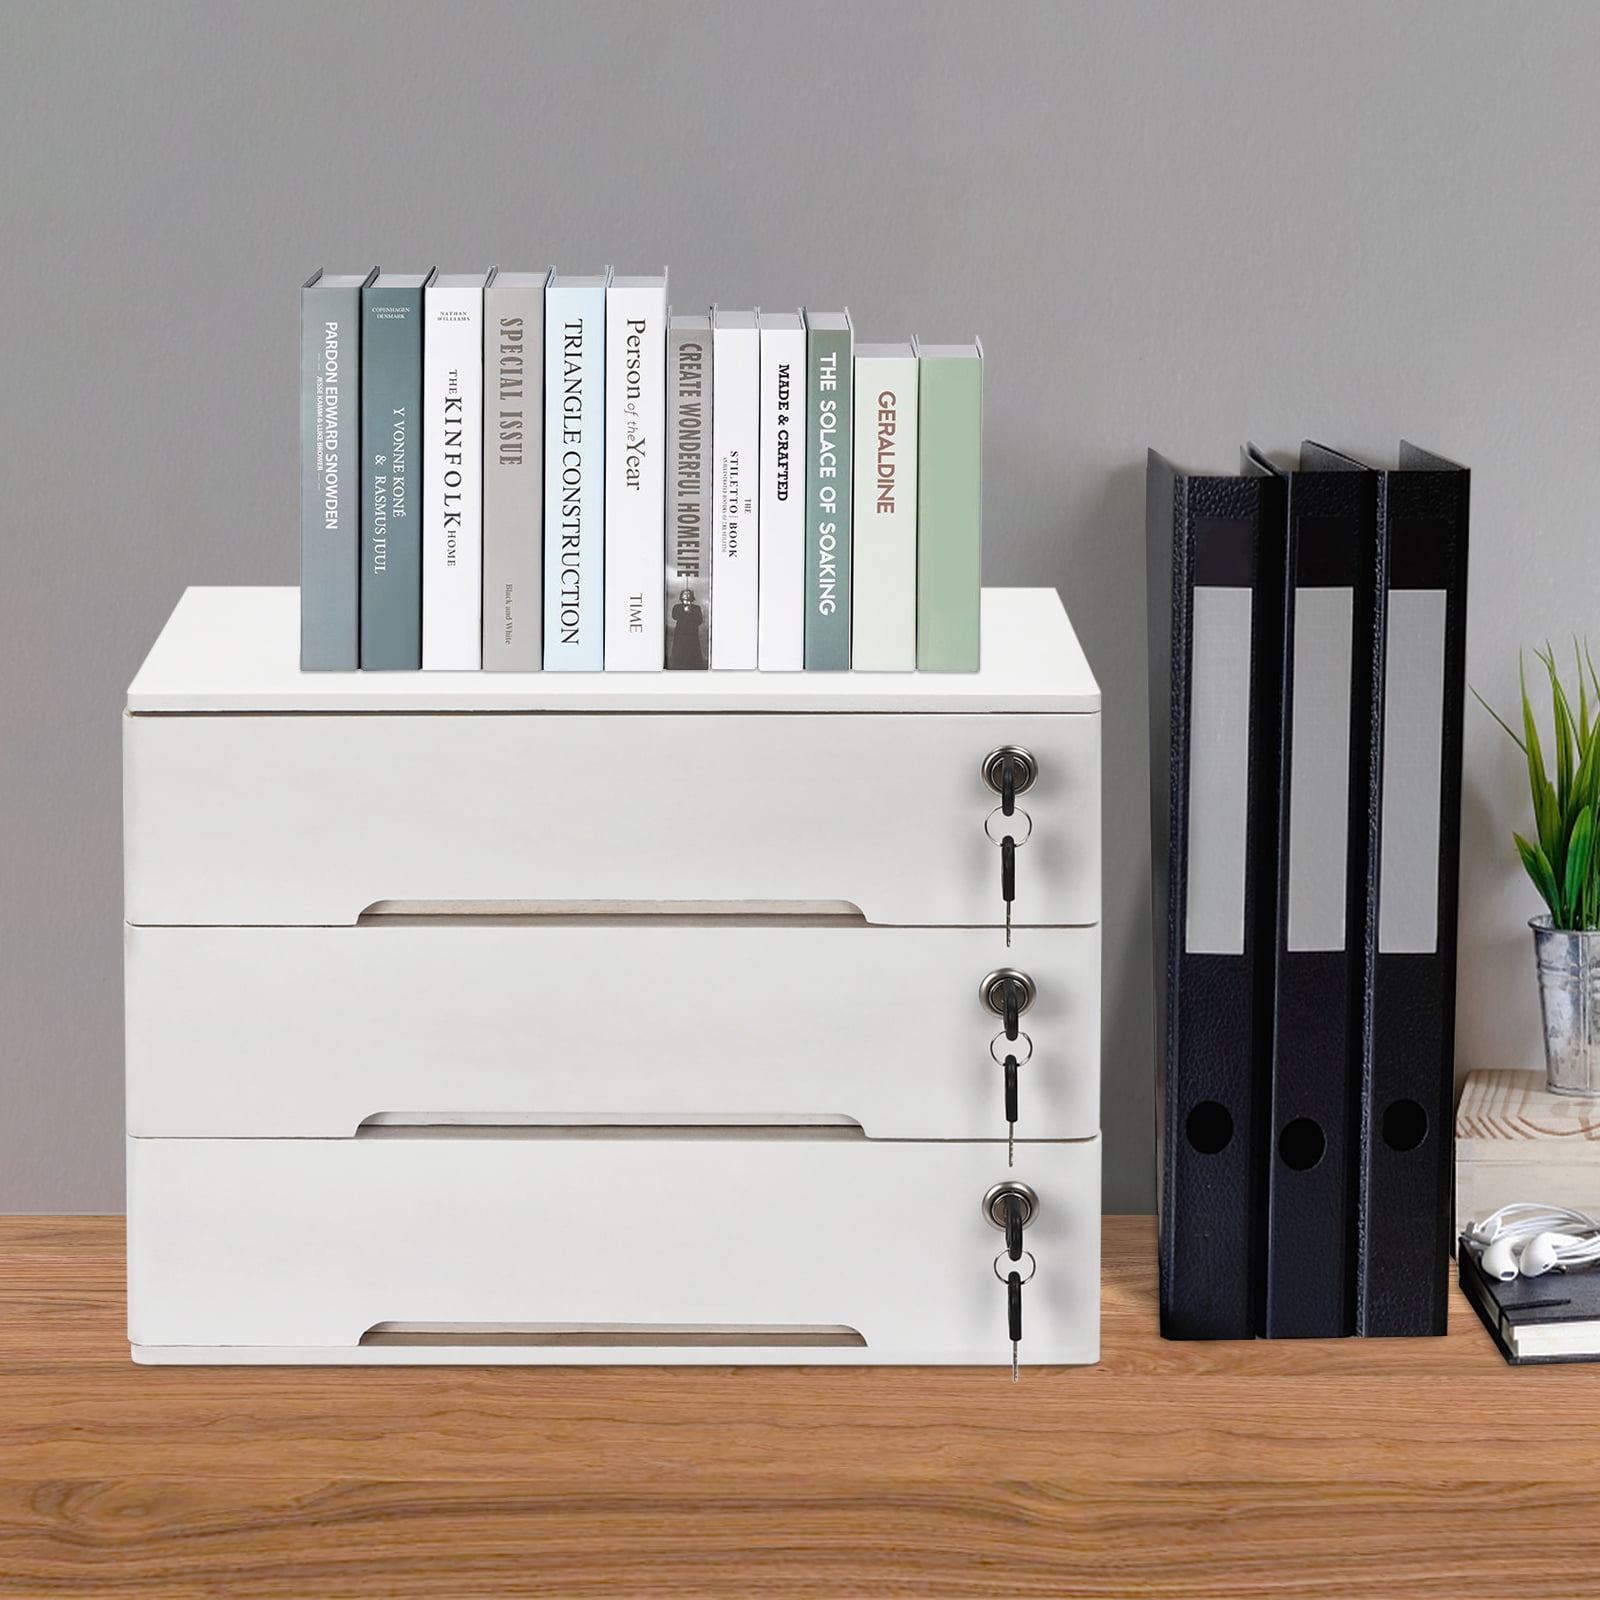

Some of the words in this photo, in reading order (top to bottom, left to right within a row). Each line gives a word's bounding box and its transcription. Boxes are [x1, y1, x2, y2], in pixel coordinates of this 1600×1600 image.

[325, 322, 338, 382] PARDON
[499, 318, 523, 401] SPECIAL
[626, 319, 647, 399] Person
[678, 342, 703, 398] CREATE
[819, 352, 837, 392] THE
[448, 370, 457, 395] THE
[563, 319, 583, 444] TRIANGLE
[777, 364, 790, 411] MADE
[325, 387, 338, 450] EDWARD
[393, 407, 405, 416] Y
[625, 402, 638, 417] of
[626, 420, 636, 442] the
[777, 414, 789, 426] &
[375, 454, 386, 465] &
[393, 421, 405, 473] VONNE
[443, 397, 462, 528] KINFOLK
[499, 411, 523, 465] ISSUE
[625, 437, 647, 491] Year
[677, 403, 701, 499] WONDERFUL
[777, 429, 789, 502] CRAFTED
[819, 400, 837, 479] SOLACE
[876, 391, 897, 514] GERALDINE
[325, 454, 338, 529] SNOWDEN
[374, 475, 386, 535] RASMUS
[392, 476, 406, 517] KONÉ
[729, 450, 739, 514] STILETTO
[819, 486, 837, 515] OF
[372, 537, 386, 574] JUUL
[446, 530, 457, 567] HOME
[560, 451, 582, 645] CONSTRUCTION
[676, 502, 700, 578] HOMELIFE
[729, 522, 737, 558] BOOK
[818, 522, 837, 616] SOAKING
[628, 592, 644, 633] TIME
